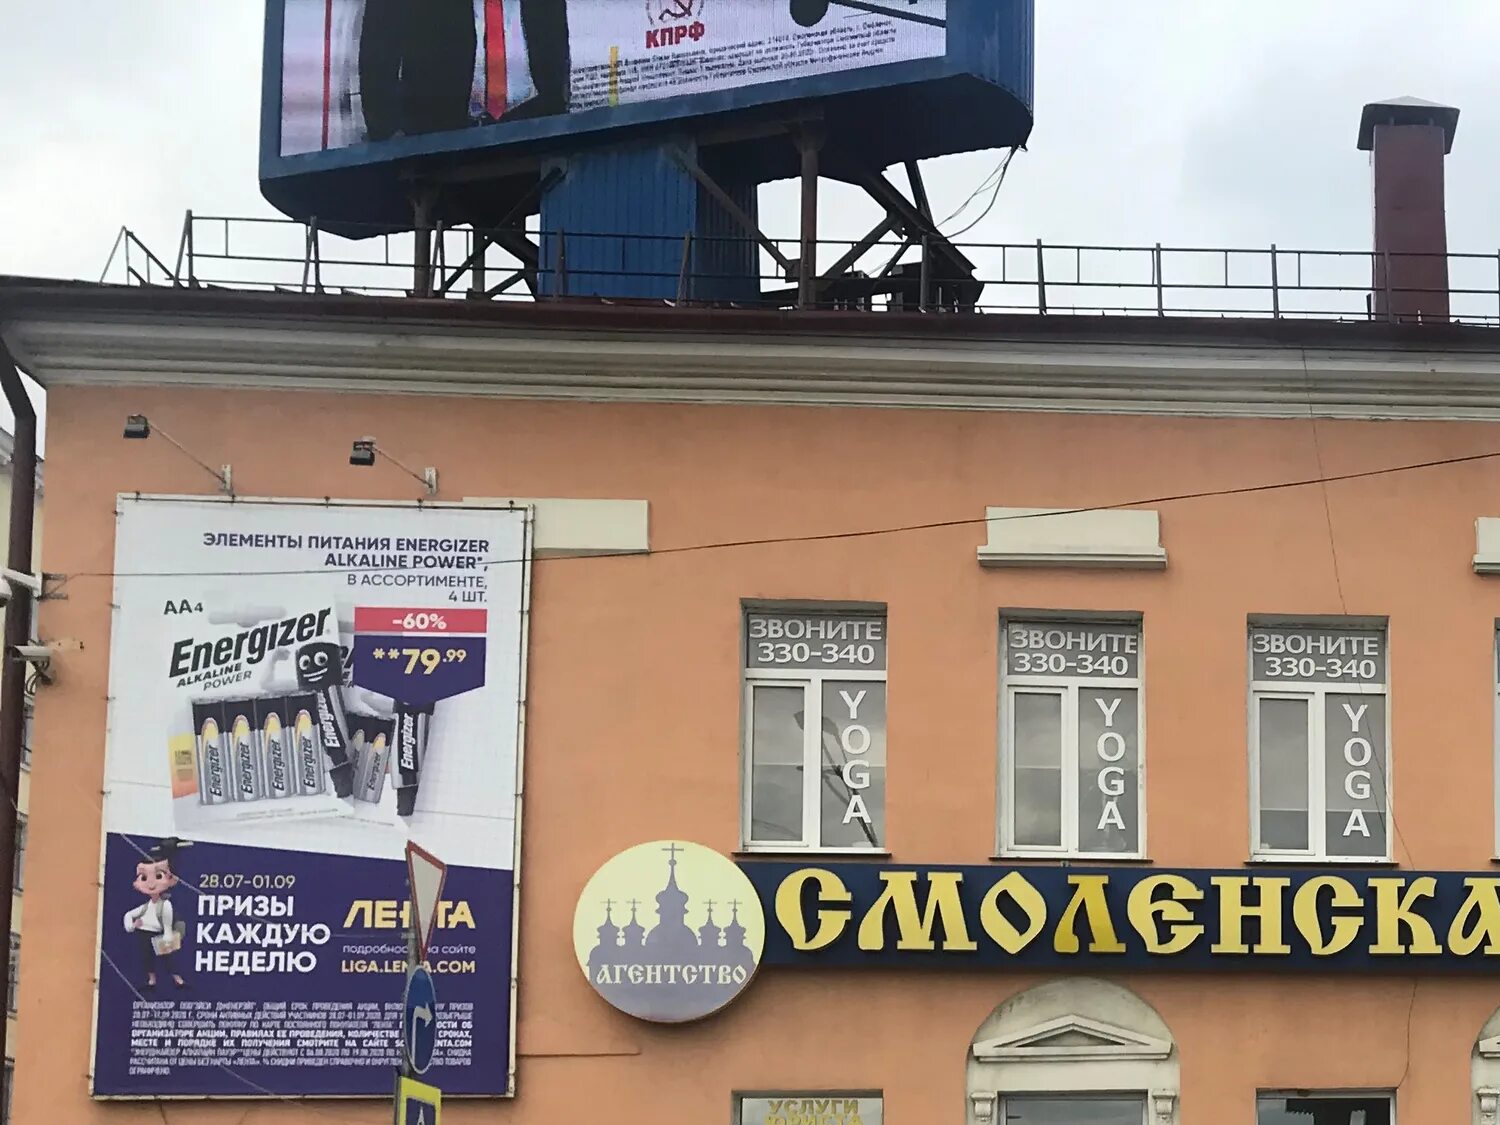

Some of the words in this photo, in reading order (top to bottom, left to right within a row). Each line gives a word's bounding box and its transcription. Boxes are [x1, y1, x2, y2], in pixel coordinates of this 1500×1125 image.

[646, 21, 705, 49] КПРФ
[203, 532, 303, 549] ЭЛЕМЕНТЫ
[308, 536, 391, 551] ПИТАНИЯ
[396, 538, 489, 553] ENERGIZER
[325, 554, 408, 569] ALKALINE
[347, 574, 356, 586] В
[360, 574, 488, 589] АССОРТИМЕНТЕ,
[448, 590, 458, 602] 4
[463, 591, 488, 603] ШТ.
[392, 613, 447, 629] -60%
[749, 619, 882, 641] ЗВОНИТЕ
[169, 607, 331, 679] Energizer
[1010, 629, 1137, 655] ЗВОНИТЕ
[1253, 634, 1379, 656] ЗВОНИТЕ
[757, 643, 875, 666] 330-340
[1014, 653, 1129, 676] 330-340
[176, 661, 242, 688] ALKALINE
[1265, 657, 1376, 679] 330-340
[203, 670, 252, 691] POWER
[401, 713, 415, 771] Energizer
[241, 742, 253, 794] Energizer
[272, 740, 285, 791] Energizer
[303, 736, 316, 788] Energizer
[839, 690, 873, 825] YOGA
[1095, 698, 1127, 830] YOGA
[209, 744, 222, 797] Energizer
[1342, 703, 1372, 837] YOGA
[200, 873, 296, 890] 28.07-01.09
[198, 895, 294, 917] ПРИЗЫ
[196, 923, 331, 948] КАЖДУЮ
[441, 944, 476, 955] сайте
[195, 951, 317, 975] НЕДЕЛЮ
[341, 959, 476, 974] LIGA.LENA.COM
[596, 963, 748, 985] АГЕНТСТВО
[130, 1038, 158, 1046] МЕСТЕ
[164, 1039, 172, 1047] И
[178, 1039, 216, 1047] ПОРЯДКЕ
[222, 1039, 234, 1047] ИХ
[242, 1039, 290, 1047] ПОЛУЧЕНИЯ
[296, 1039, 338, 1047] СМОТРИТЕ
[344, 1039, 356, 1047] НА
[132, 1030, 194, 1038] ОРГАНИЗАТОРЕ
[230, 1030, 274, 1038] ПРАВИЛАХ
[348, 1030, 400, 1038] КОЛИЧЕСТВЕ
[767, 1099, 860, 1115] УСЛУГИ
